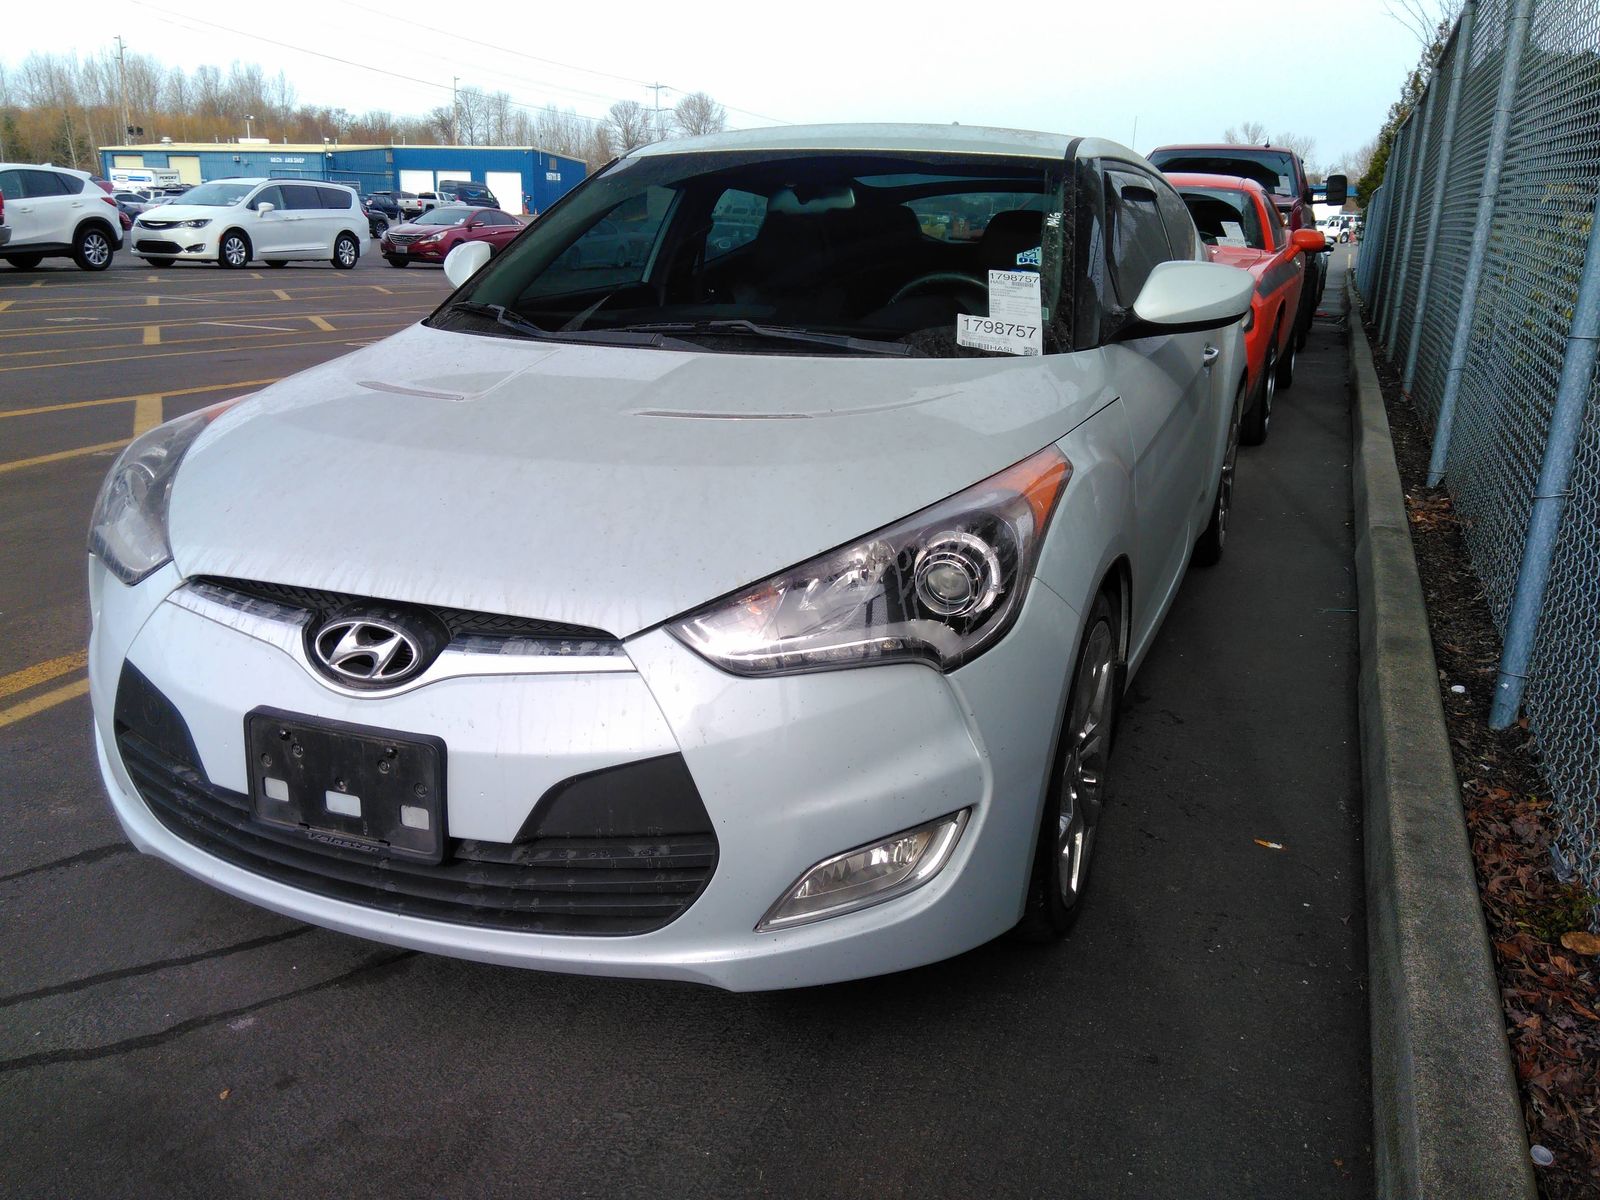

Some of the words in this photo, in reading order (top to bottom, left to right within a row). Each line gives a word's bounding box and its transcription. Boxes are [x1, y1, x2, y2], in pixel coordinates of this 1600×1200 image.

[990, 272, 1039, 283] 1798757
[964, 319, 1037, 339] 1798757
[308, 833, 380, 853] Veloster
